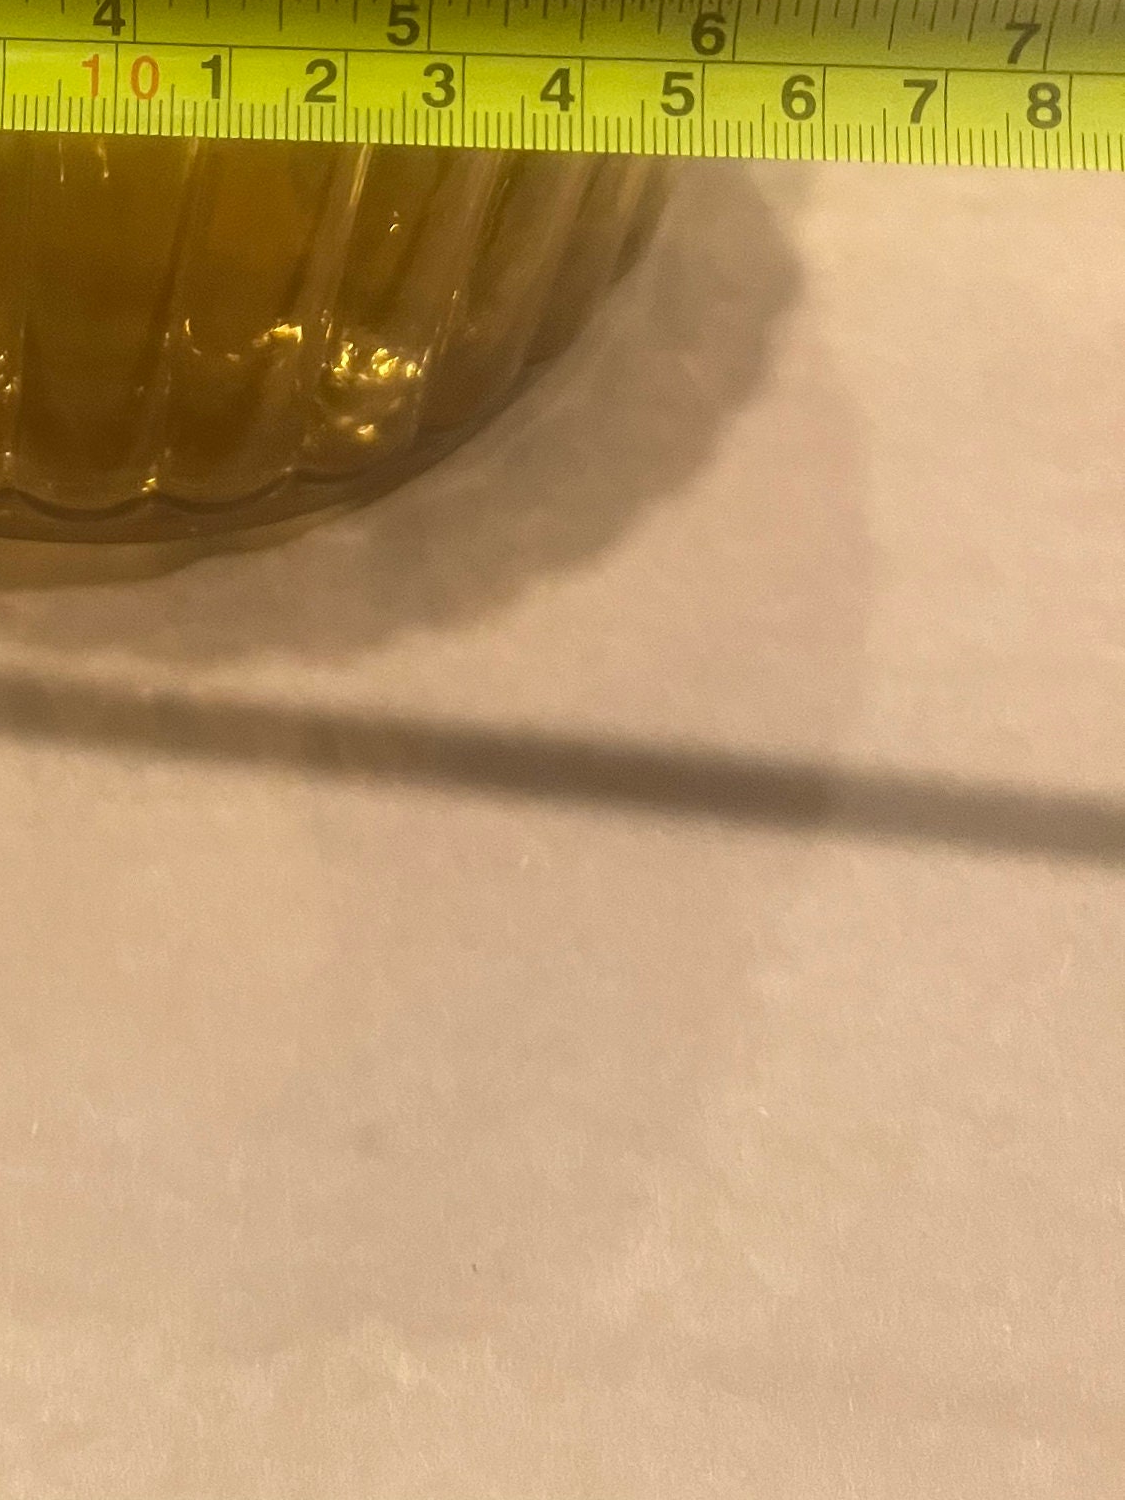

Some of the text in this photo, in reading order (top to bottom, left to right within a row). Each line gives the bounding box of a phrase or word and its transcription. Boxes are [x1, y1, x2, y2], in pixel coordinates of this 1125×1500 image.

[387, 4, 421, 46] 5
[690, 12, 727, 56] 6
[1004, 22, 1041, 65] 7
[200, 54, 222, 99] 1
[304, 58, 338, 103] 2
[421, 63, 456, 108] 3
[539, 67, 574, 111] 4
[660, 71, 695, 117] 5
[781, 74, 817, 121] 6
[903, 79, 938, 124] 7
[1026, 82, 1062, 129] 8
